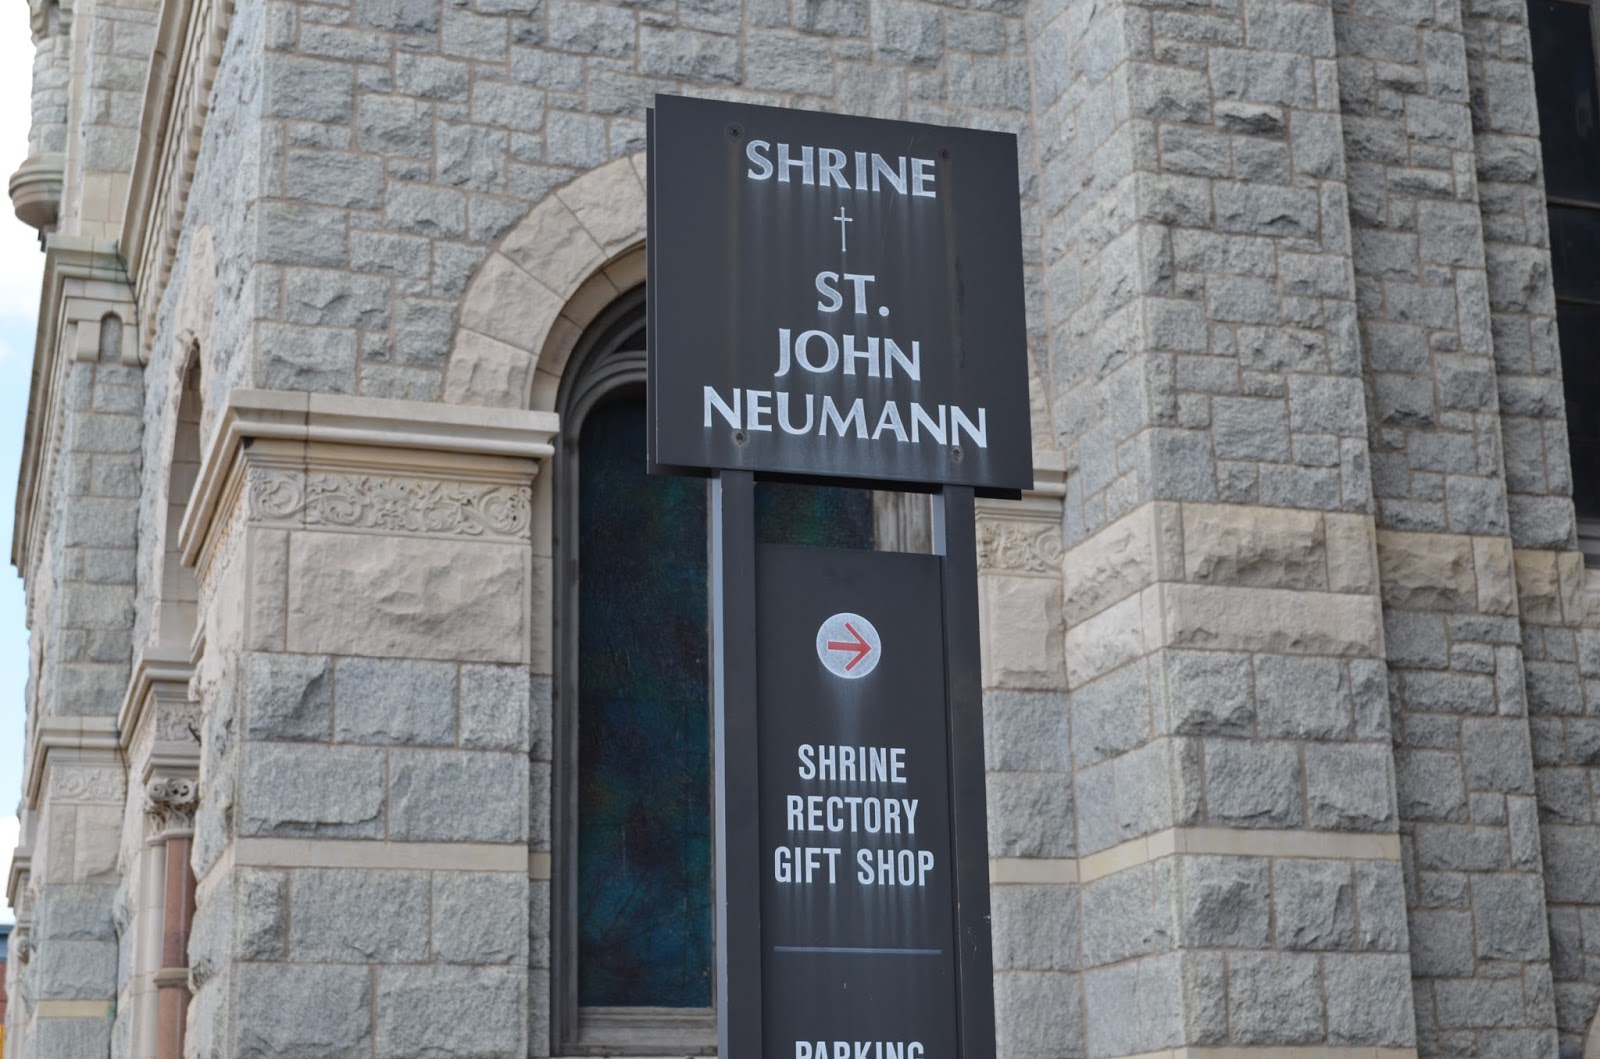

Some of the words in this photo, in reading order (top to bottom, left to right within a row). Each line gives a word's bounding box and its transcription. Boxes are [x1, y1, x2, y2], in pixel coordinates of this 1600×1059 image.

[746, 140, 936, 198] SHRINE
[815, 271, 889, 316] ST.
[774, 328, 920, 381] JOHN
[703, 385, 987, 448] NEUMANN
[798, 744, 907, 783] SHRINE
[787, 795, 918, 834] RECTORY
[775, 846, 841, 883] GIFT
[857, 849, 934, 886] SHOP
